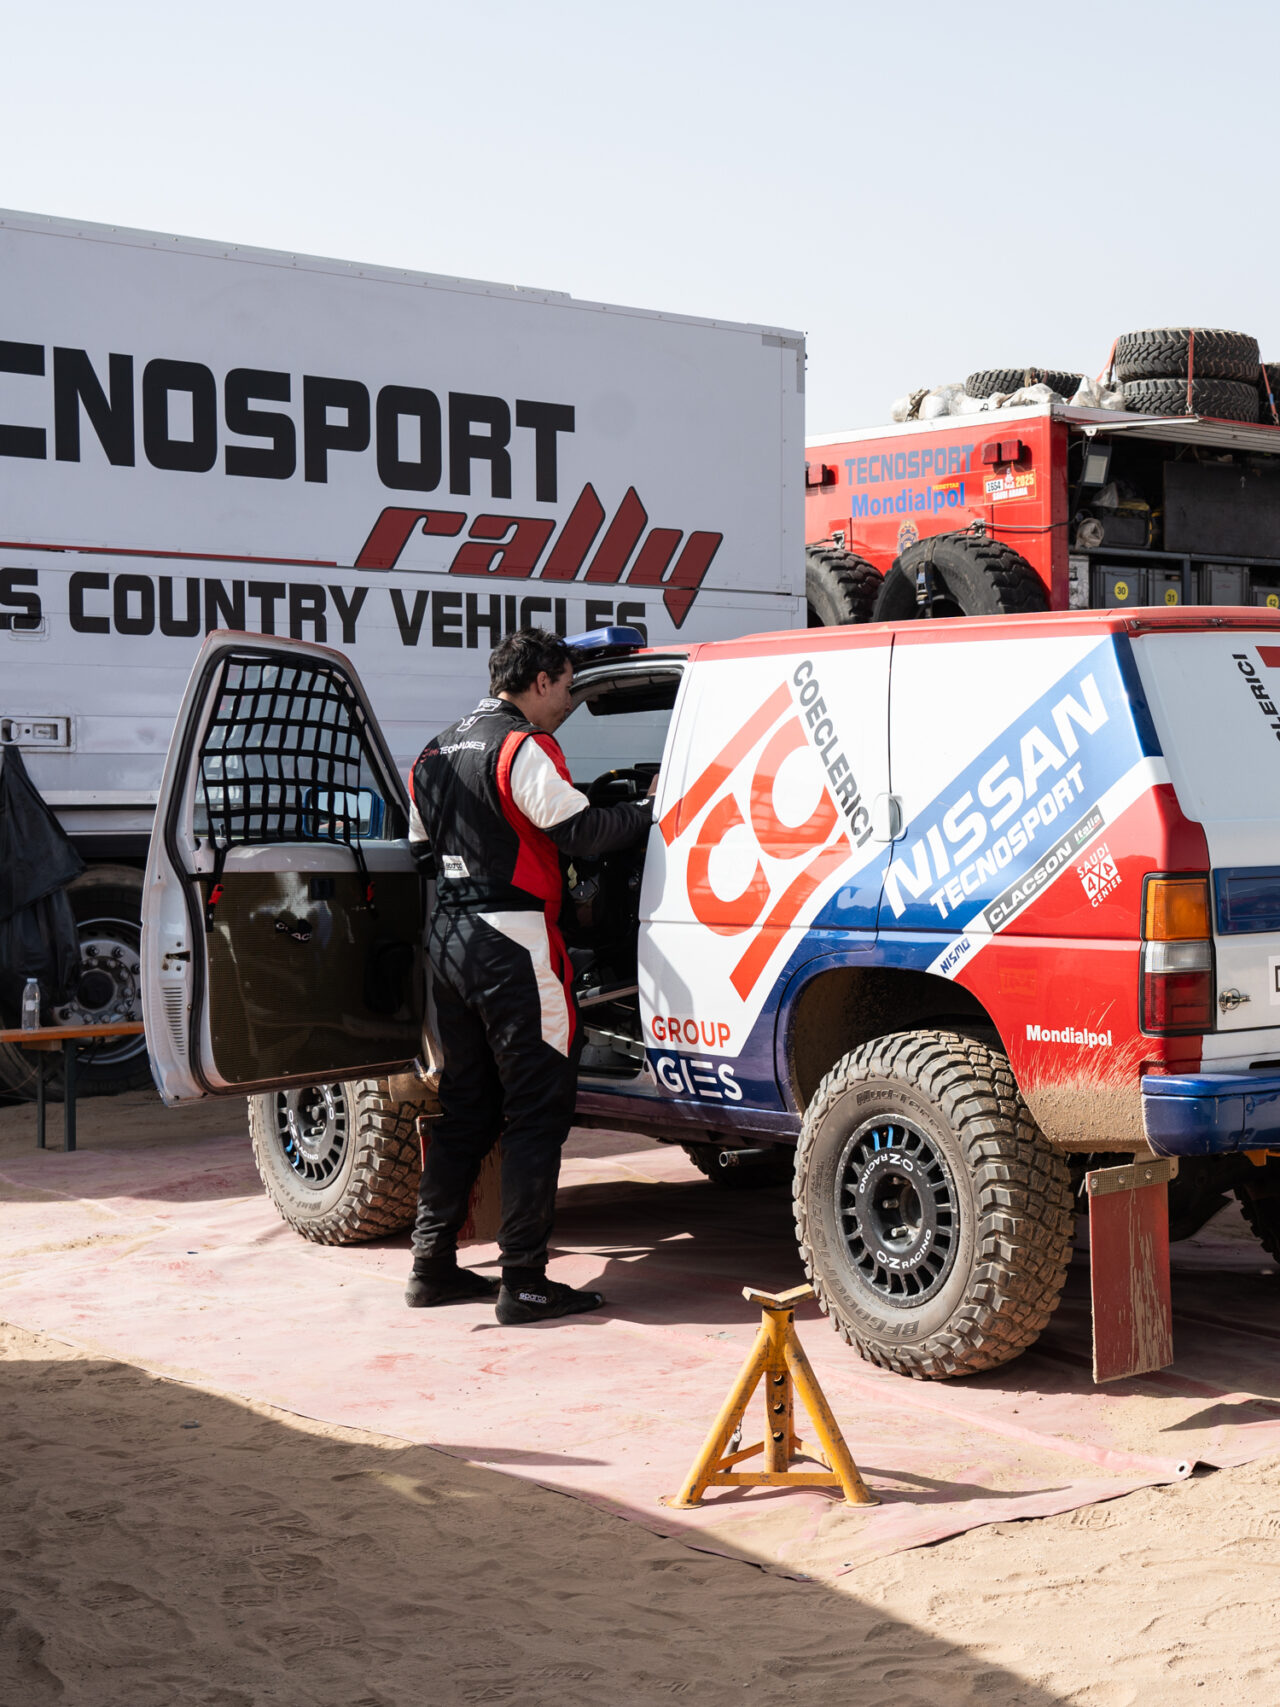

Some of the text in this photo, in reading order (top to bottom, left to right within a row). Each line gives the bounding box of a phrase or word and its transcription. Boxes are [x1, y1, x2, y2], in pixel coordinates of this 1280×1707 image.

[844, 444, 975, 485] TECNOSPORT
[852, 482, 965, 518] Mondialpol
[354, 480, 724, 629] rally
[69, 571, 369, 644] COUNTRY
[1116, 586, 1126, 596] 30
[793, 660, 875, 847] COECLERICI
[881, 672, 1110, 919] NISSAN
[929, 763, 1087, 919] TECNOSPORT
[1077, 843, 1110, 878] SAUDI
[988, 813, 1101, 926] CLACSON Italia
[1091, 875, 1123, 908] CENTER
[940, 938, 971, 974] NISMO
[652, 1015, 730, 1048] GROUP
[1026, 1024, 1112, 1047] Mondialpol
[647, 1056, 743, 1101] GIES
[859, 1153, 888, 1194] RACING
[901, 1229, 932, 1270] RACING
